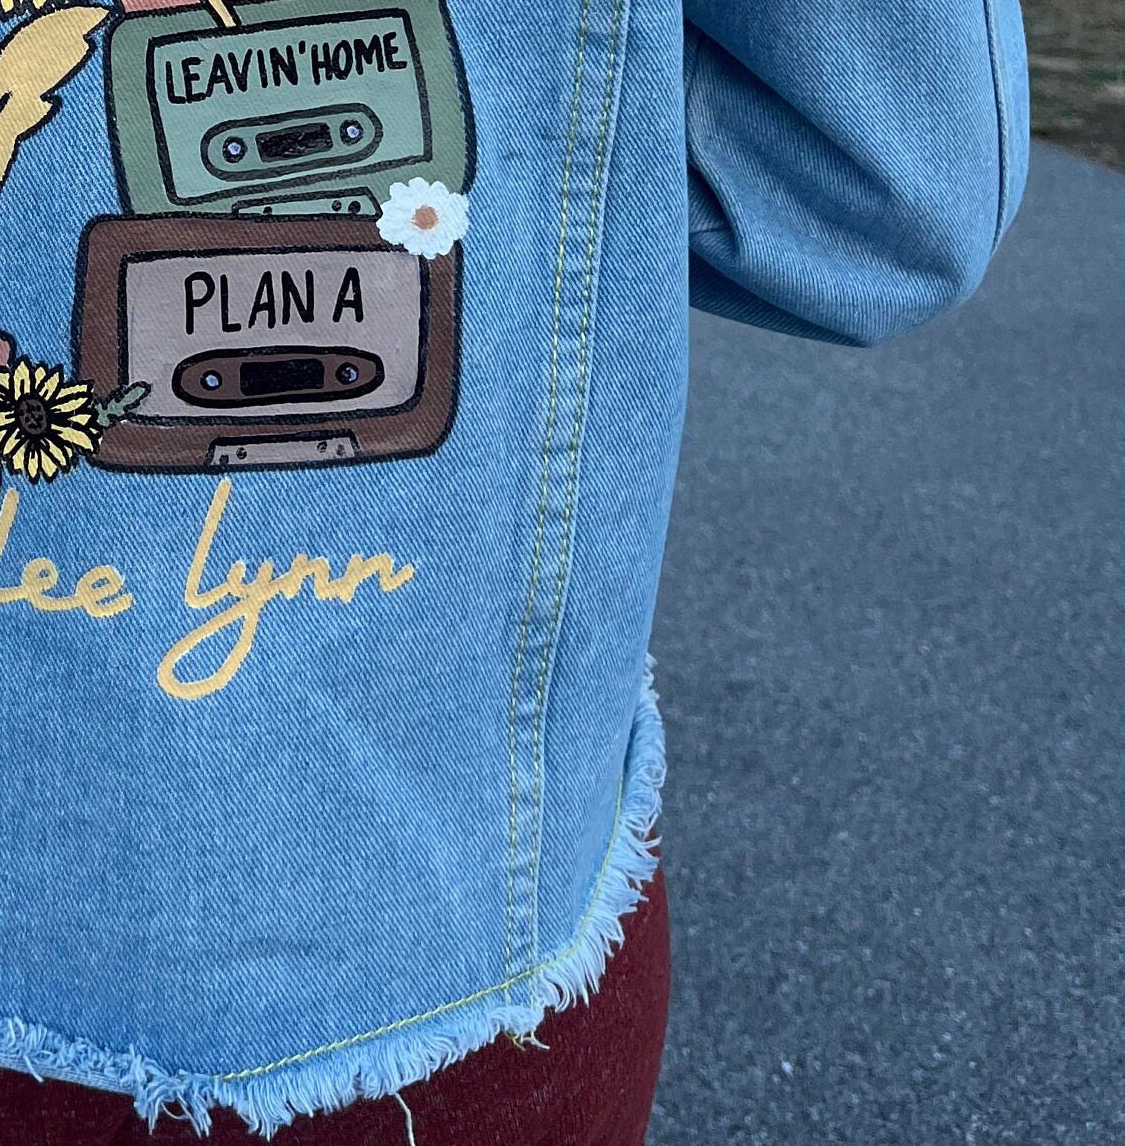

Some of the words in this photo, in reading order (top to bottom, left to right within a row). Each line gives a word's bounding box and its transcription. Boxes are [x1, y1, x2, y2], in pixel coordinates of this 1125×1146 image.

[184, 269, 315, 335] PLAN
[332, 267, 364, 324] A
[157, 479, 415, 701] lynn
